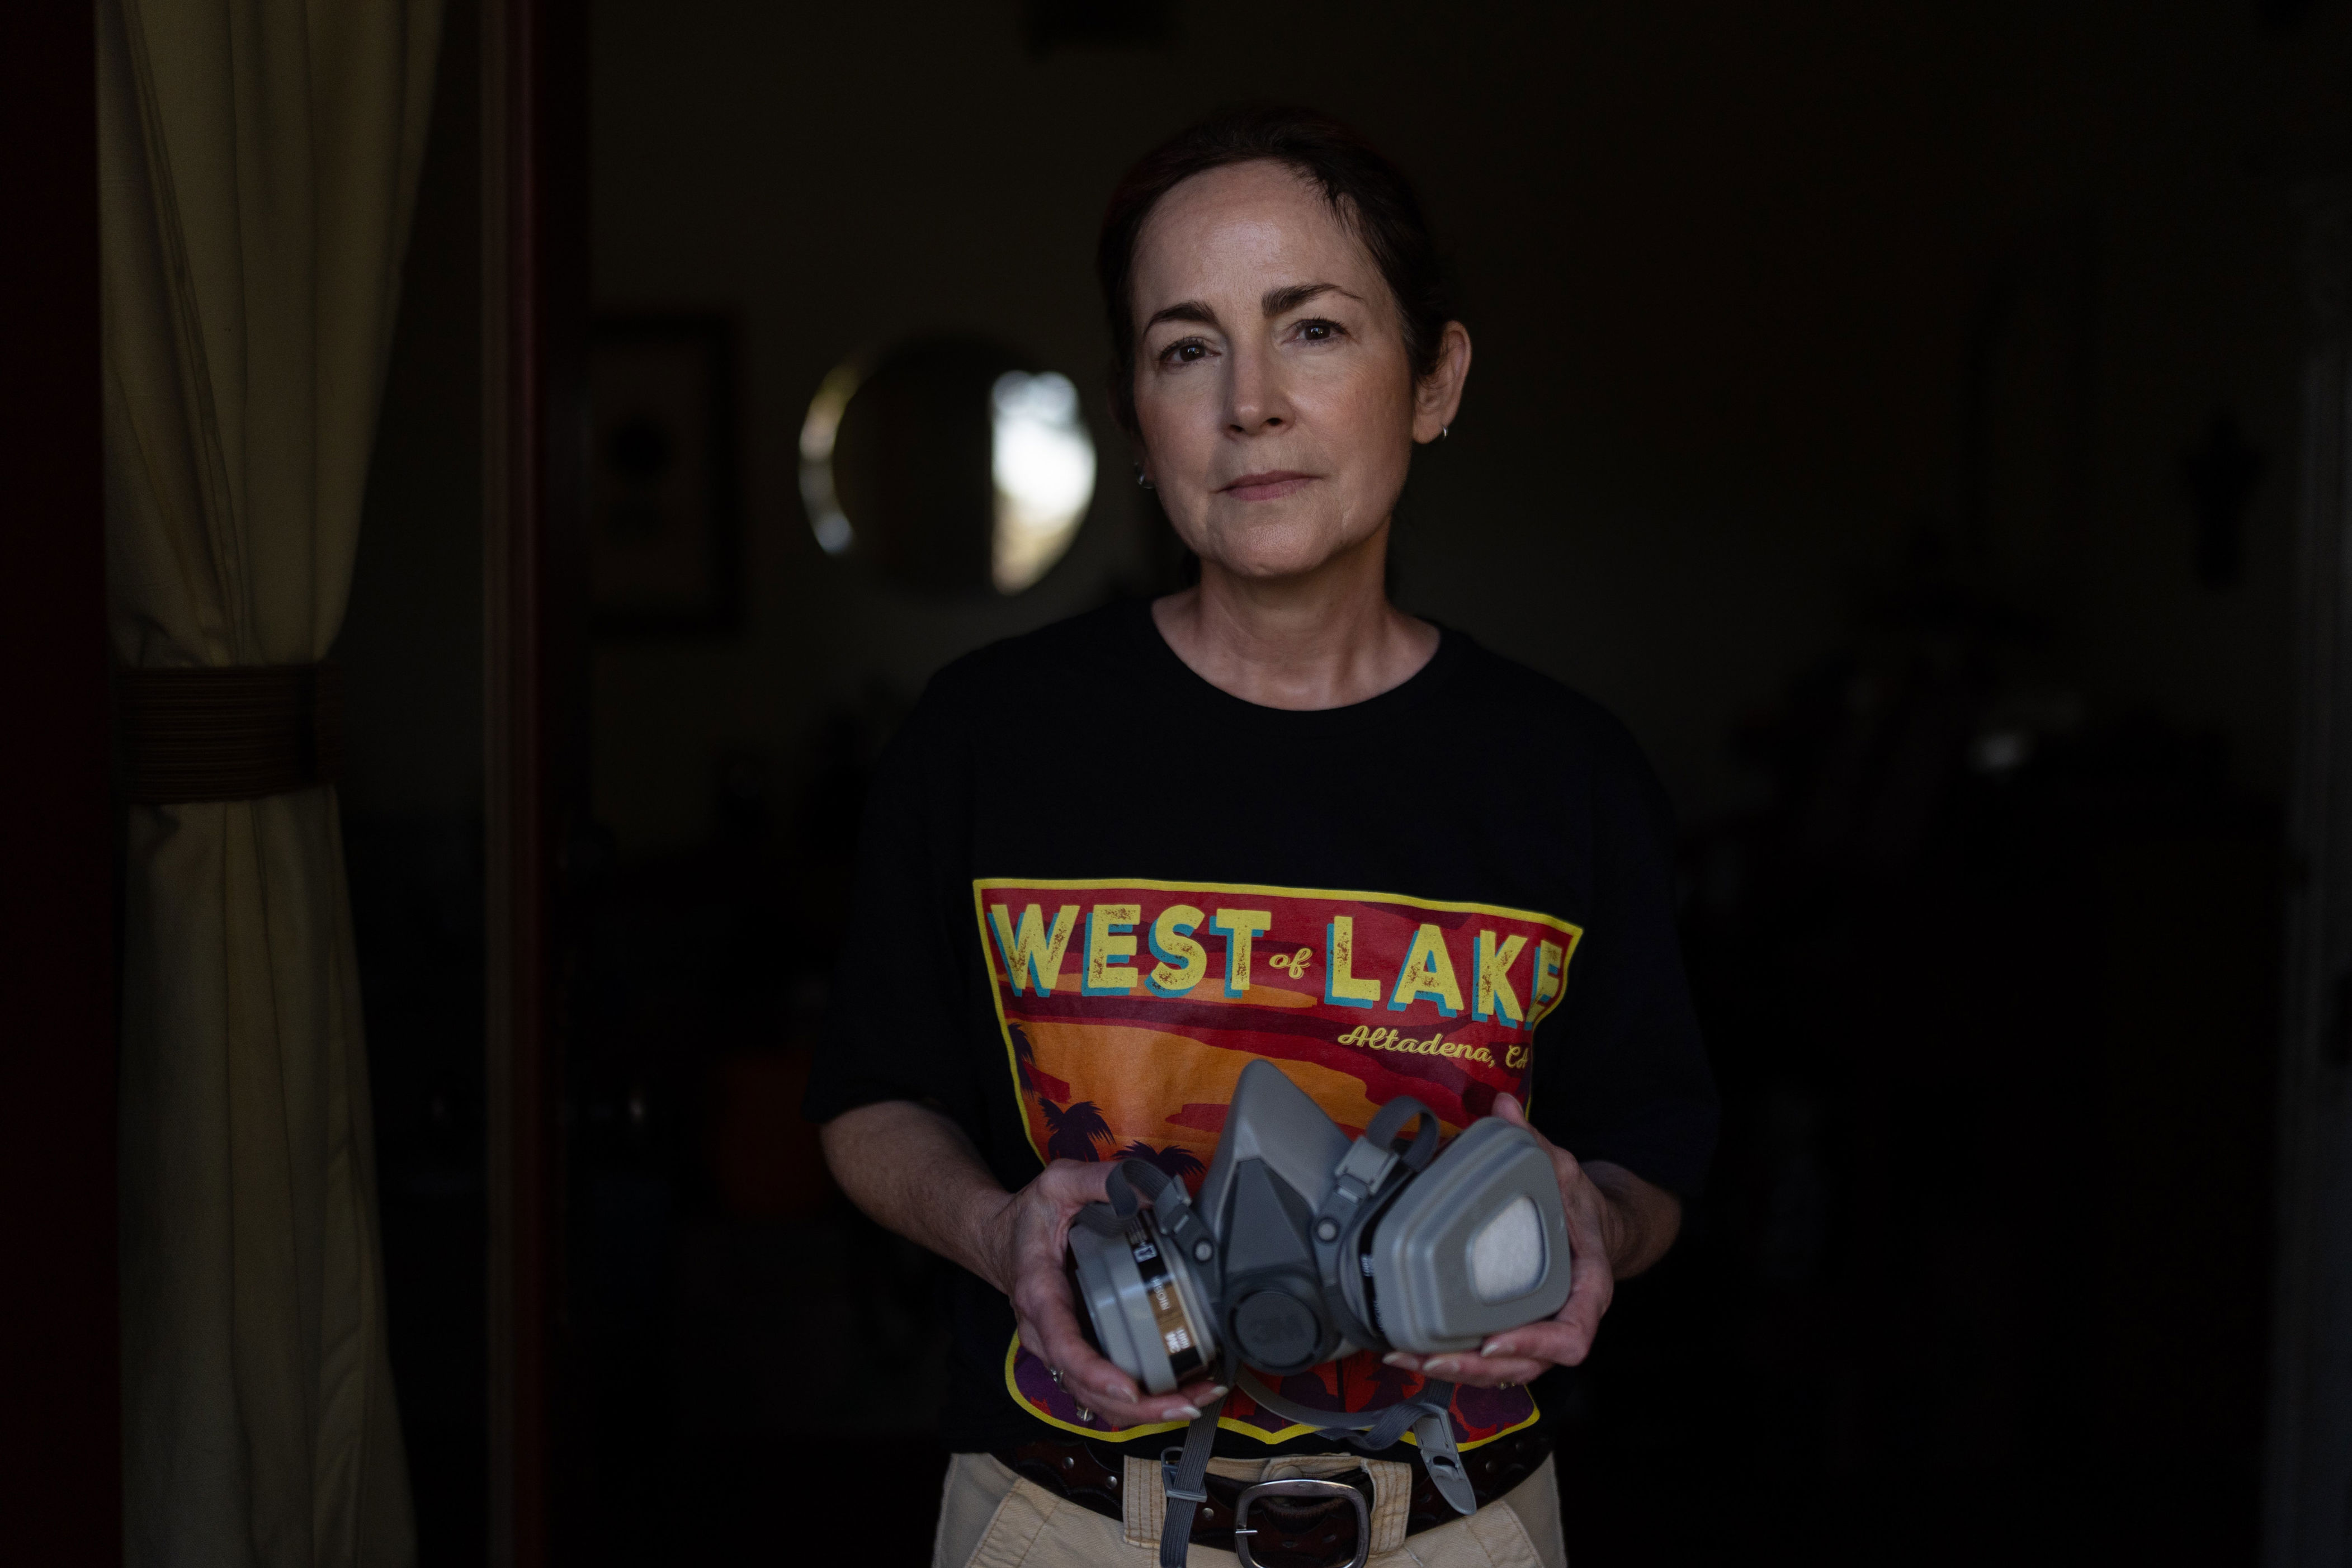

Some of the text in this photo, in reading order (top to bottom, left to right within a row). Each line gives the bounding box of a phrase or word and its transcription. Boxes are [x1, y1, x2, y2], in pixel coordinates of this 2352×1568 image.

[987, 903, 1564, 1031] WEST of LAKE
[1337, 1024, 1495, 1069] Altadena,
